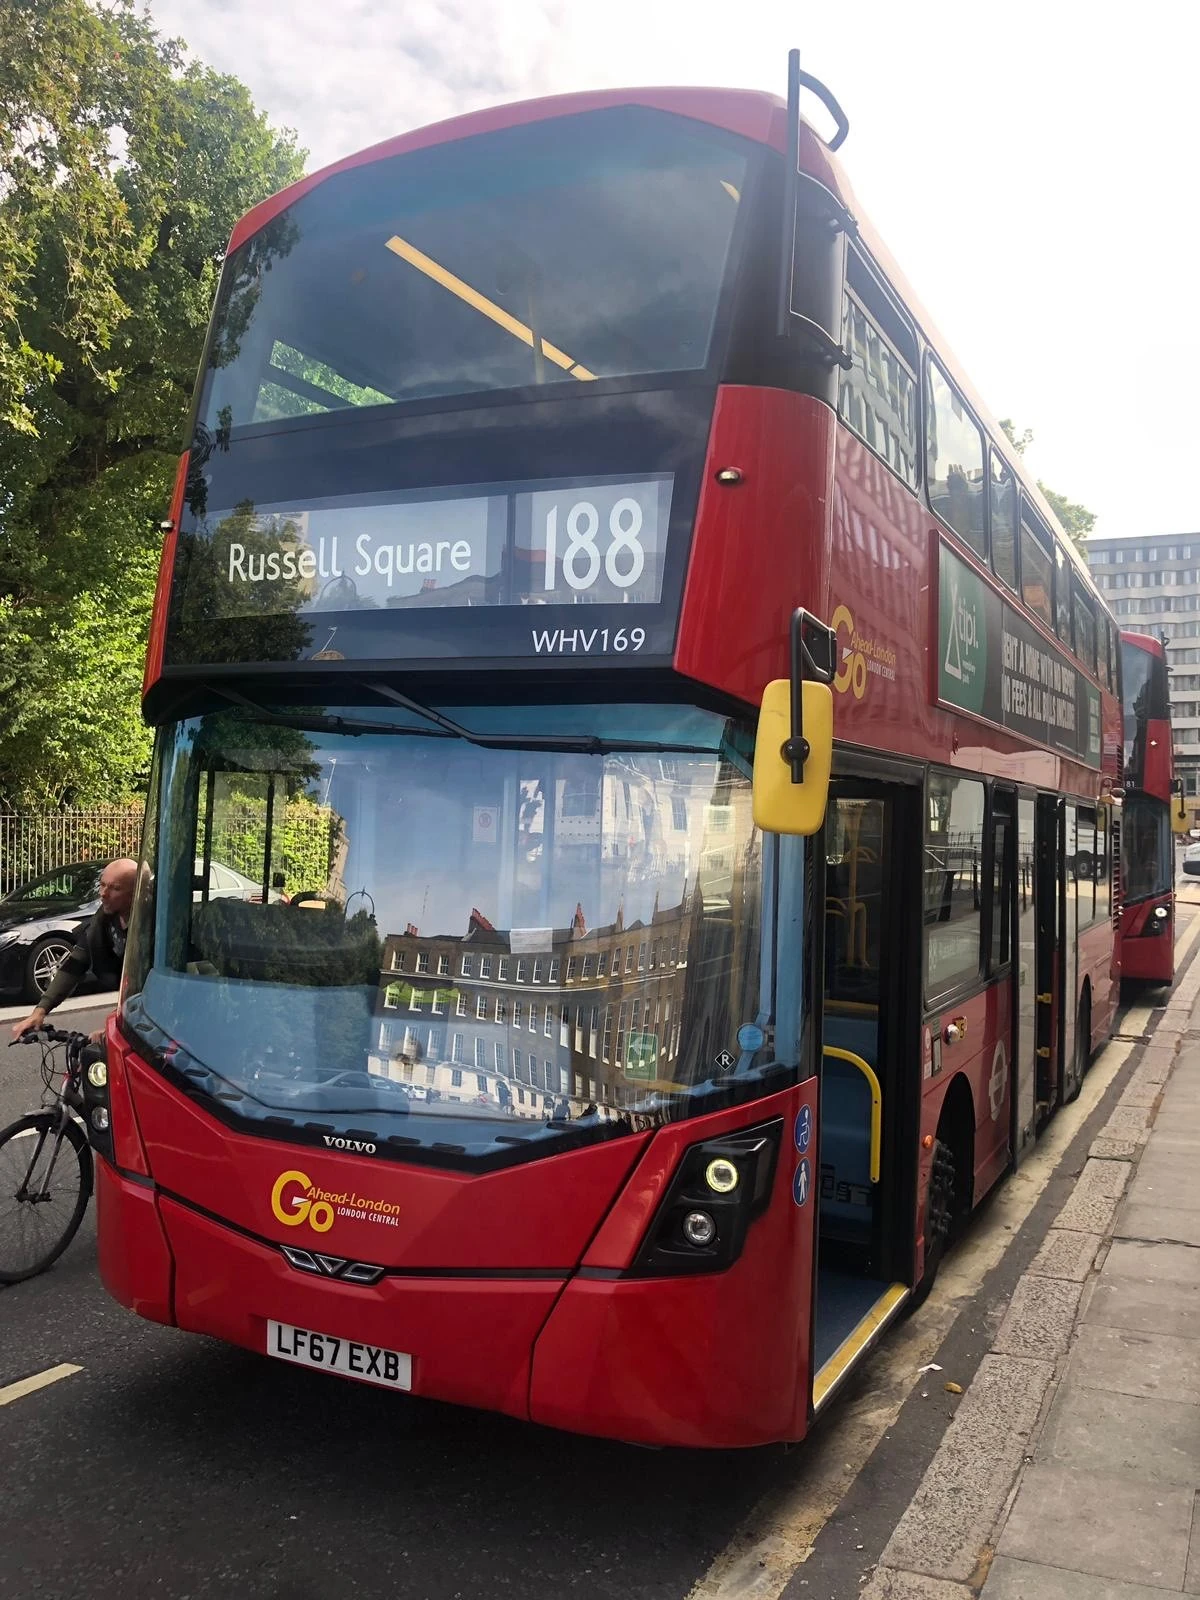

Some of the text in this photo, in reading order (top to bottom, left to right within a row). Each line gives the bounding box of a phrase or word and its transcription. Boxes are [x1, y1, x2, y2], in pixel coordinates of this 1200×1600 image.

[228, 533, 472, 587] Russell Square
[544, 497, 645, 591] 188
[531, 627, 646, 654] WHV169
[1012, 678, 1027, 718] FEES
[323, 1135, 377, 1154] VOLVO
[271, 1170, 335, 1233] Go
[307, 1186, 400, 1215] Ahead-London
[337, 1206, 399, 1227] LONDON CENTRAL
[277, 1324, 400, 1381] LF67 EXB
